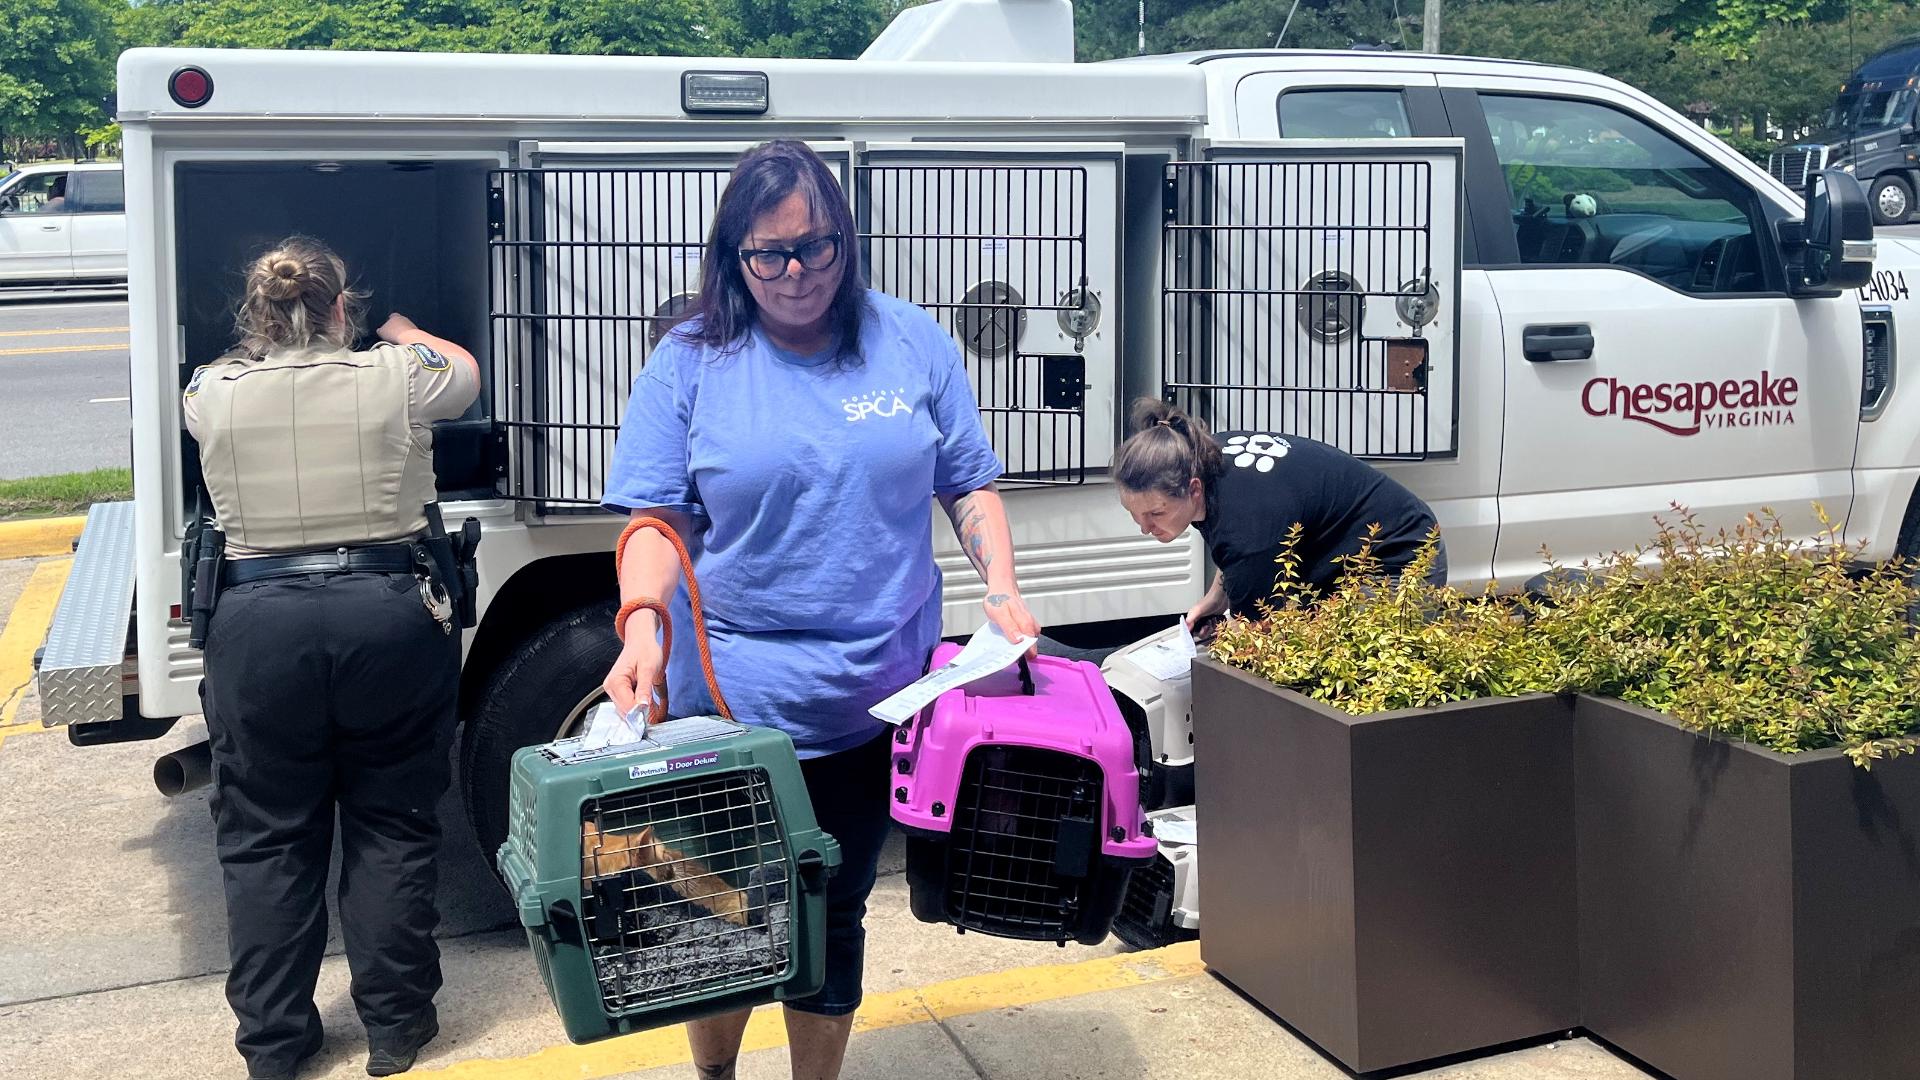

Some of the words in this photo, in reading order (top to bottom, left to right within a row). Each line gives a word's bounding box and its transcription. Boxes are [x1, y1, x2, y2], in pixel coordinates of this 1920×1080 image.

[843, 396, 913, 422] SPCA
[1581, 370, 1799, 436] Chesapeake
[1704, 410, 1795, 429] VIRGINIA
[675, 760, 693, 769] Door
